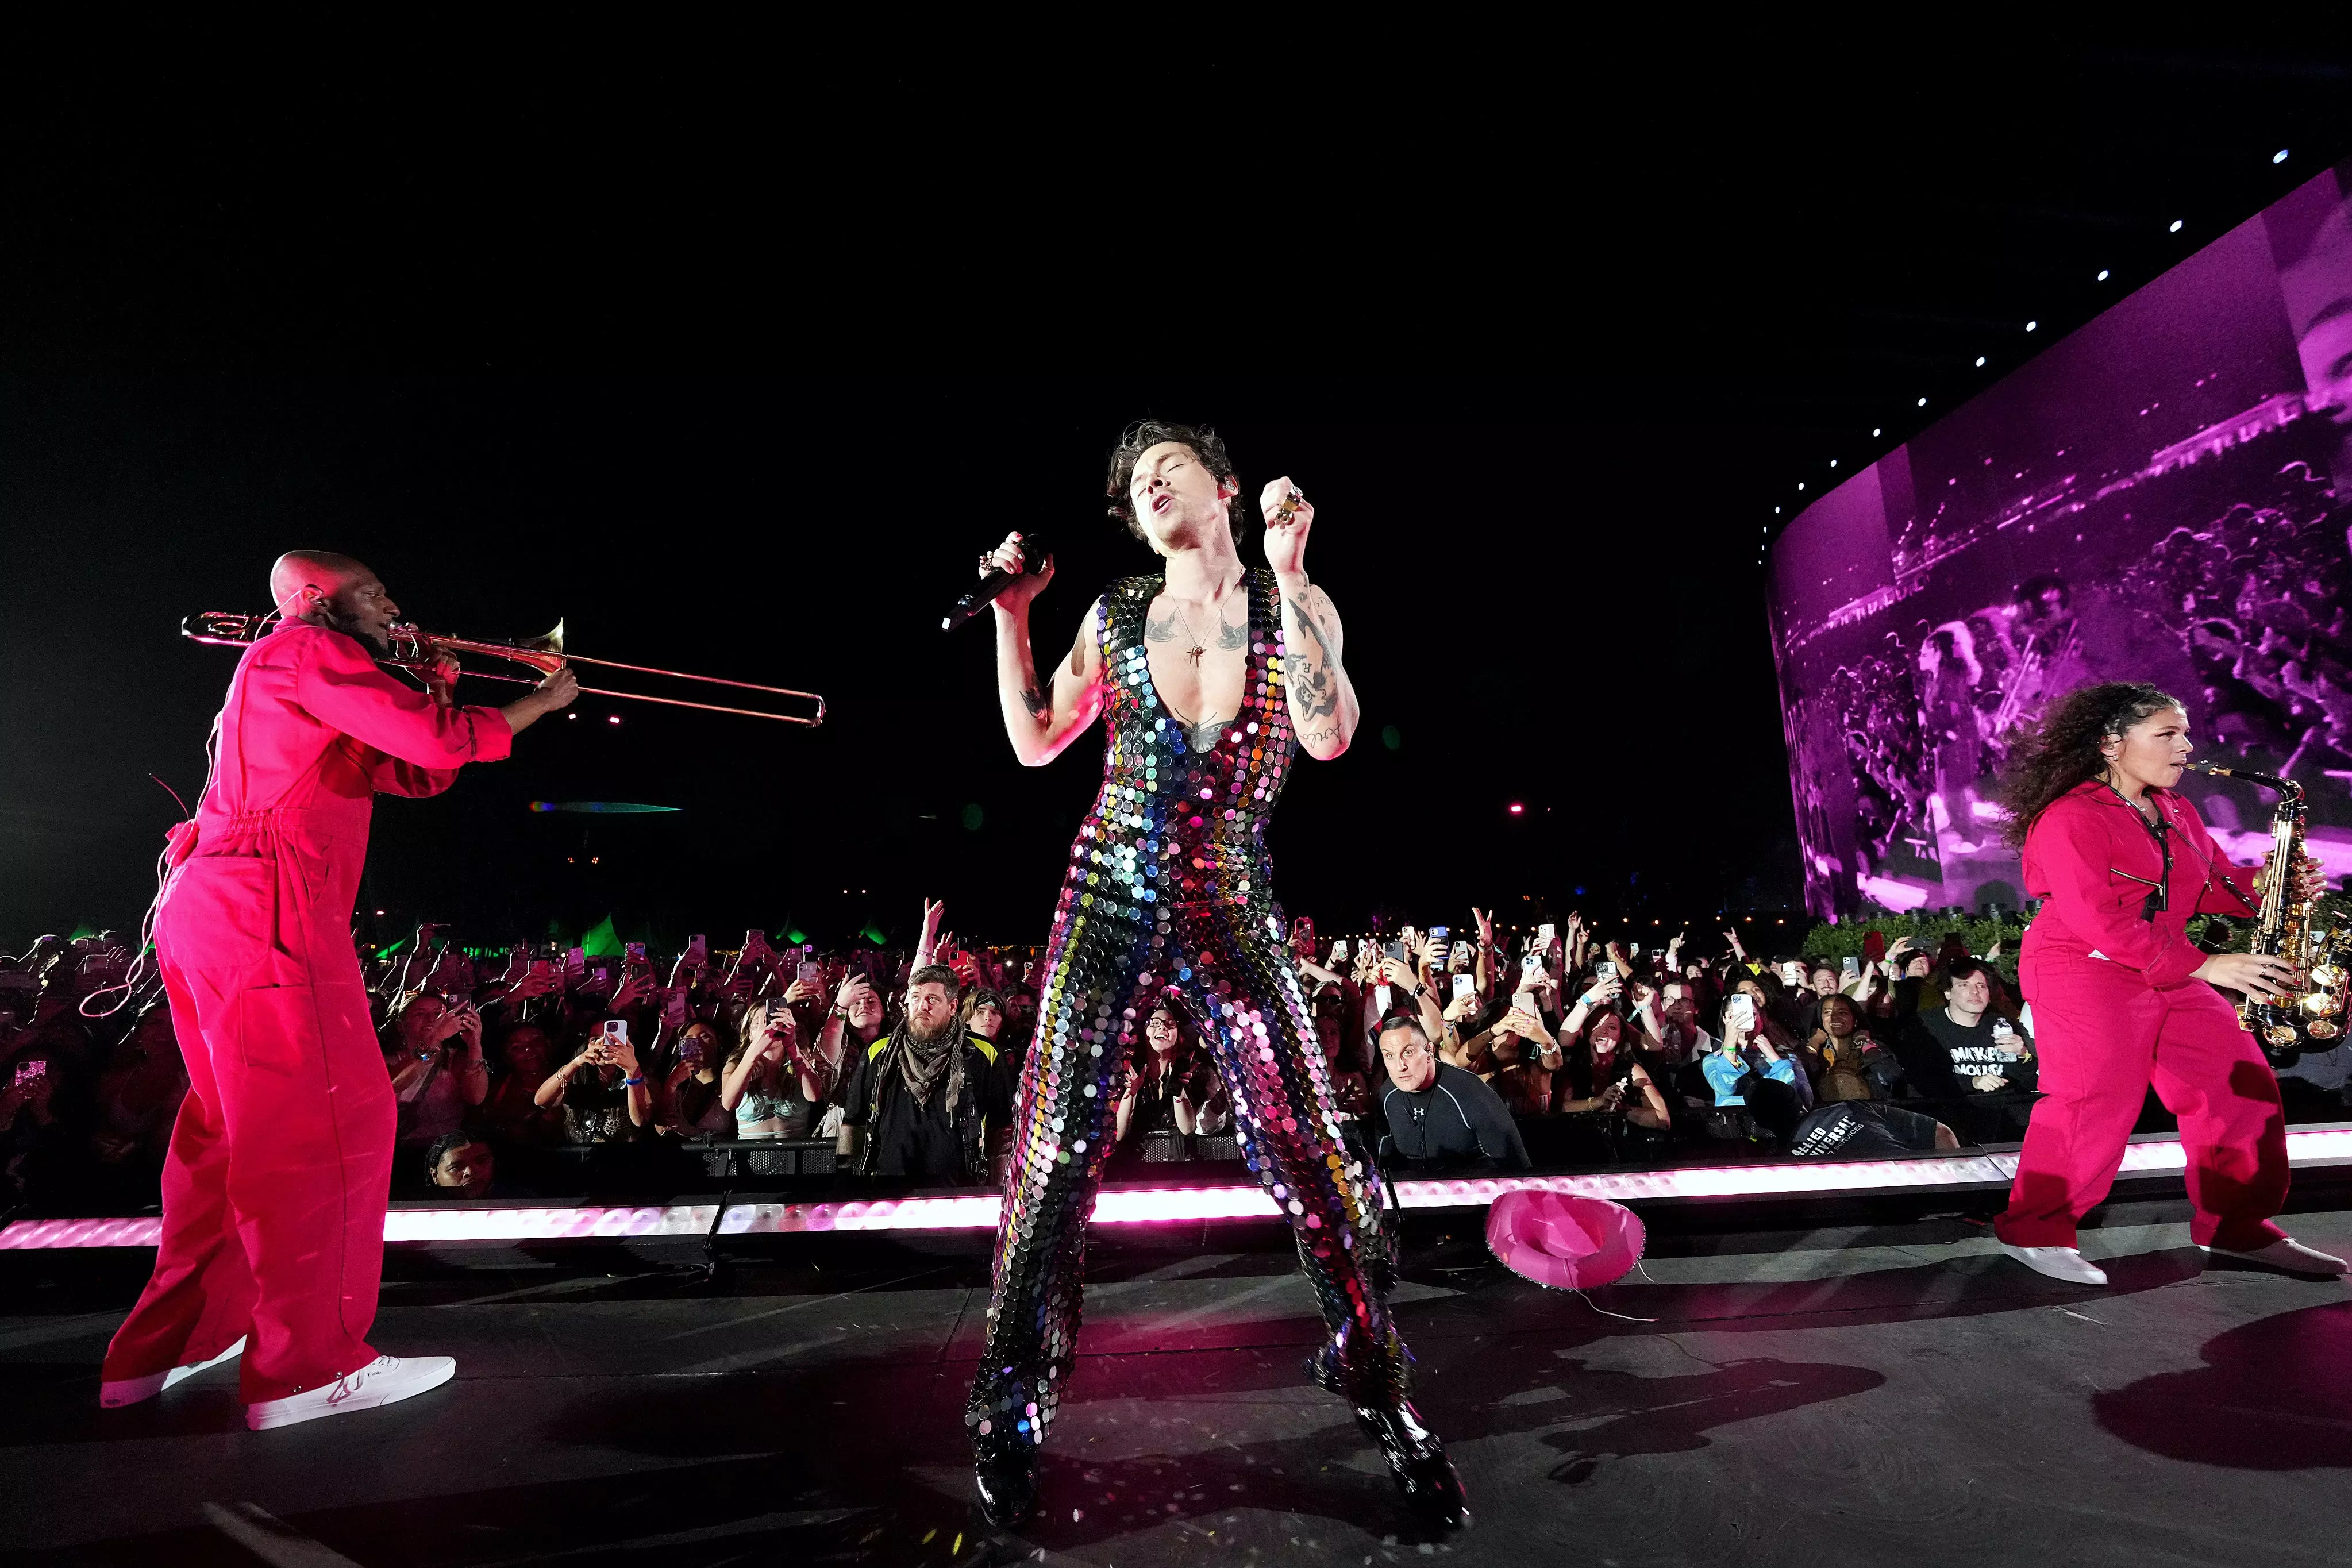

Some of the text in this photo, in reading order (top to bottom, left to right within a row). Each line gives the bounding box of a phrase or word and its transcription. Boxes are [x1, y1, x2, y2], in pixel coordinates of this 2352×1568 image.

[1300, 715, 1342, 749] Arlo
[1791, 1127, 1826, 1156] ALLIED
[1809, 1117, 1856, 1155] NIVERSAL
[1834, 1123, 1864, 1150] SERVICES
